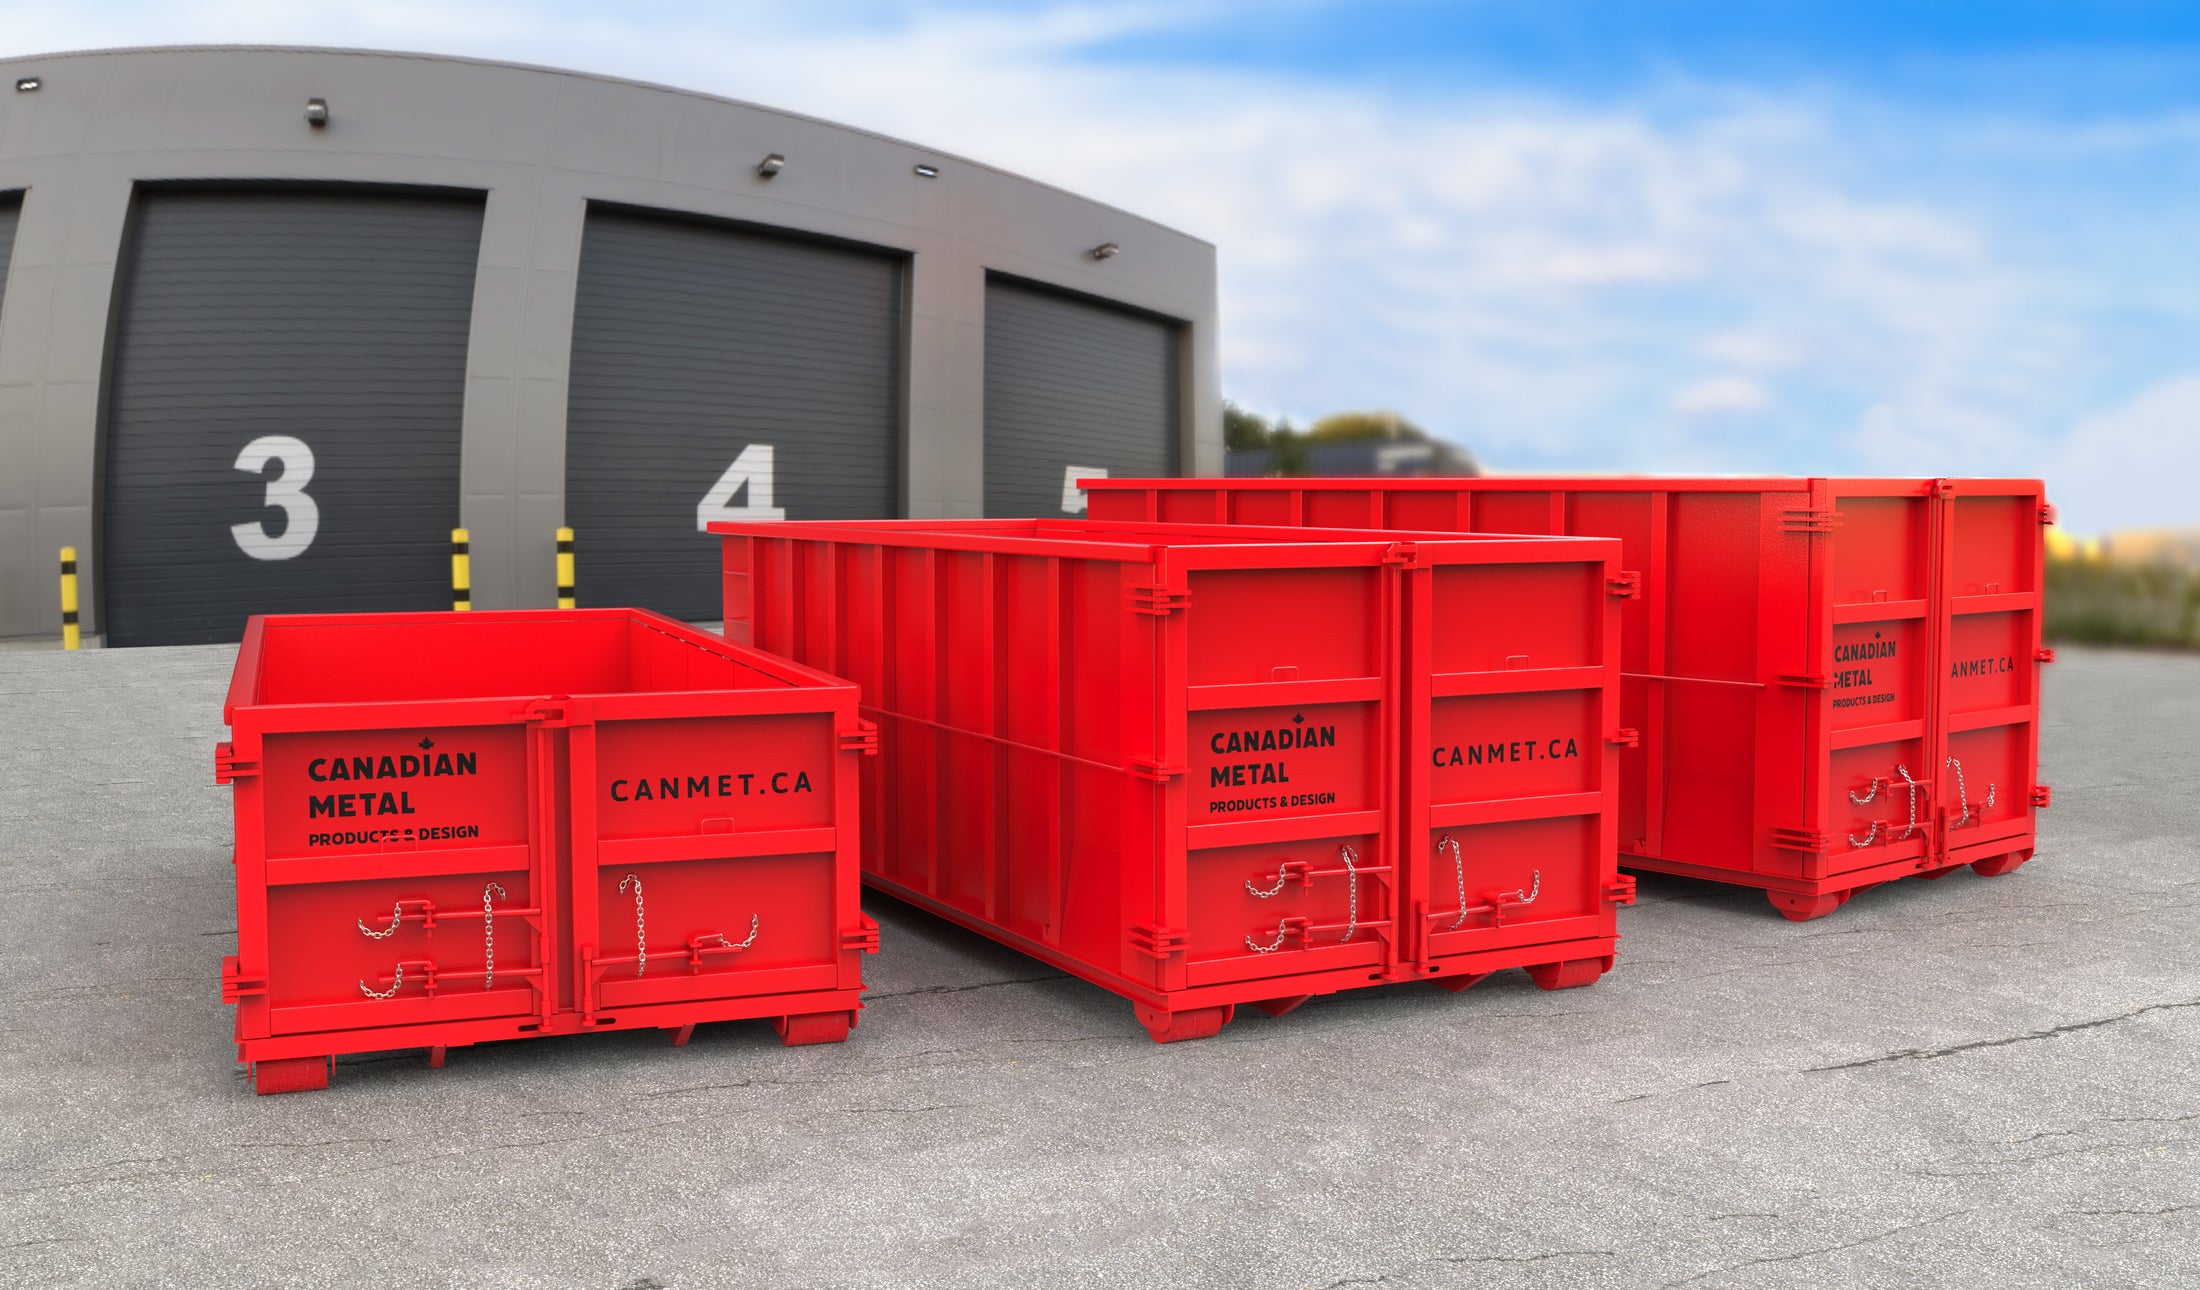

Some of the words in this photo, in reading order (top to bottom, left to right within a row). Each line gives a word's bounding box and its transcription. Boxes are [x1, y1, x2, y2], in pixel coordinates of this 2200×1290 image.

[231, 436, 319, 560] 3
[697, 444, 786, 531] 4
[1834, 641, 1896, 662] CANADIAN
[1833, 669, 1873, 689] METAL
[1951, 656, 2014, 678] ANMET.CA
[1832, 695, 1866, 709] PRODUCTS
[1867, 696, 1872, 705] &
[1872, 693, 1895, 704] DESIGN
[1210, 725, 1335, 754] CANADIAN
[1432, 738, 1578, 768] CANMET.CA
[308, 752, 476, 782] CANADIAN
[1210, 762, 1289, 787] METAL
[610, 771, 812, 802] CANMET.CA
[309, 791, 415, 819] METAL
[1209, 797, 1277, 813] PRODUCTS
[1279, 798, 1288, 808] &
[1290, 792, 1335, 807] DESIGN
[309, 829, 399, 847] PRODUCTS
[403, 828, 415, 842] &
[419, 825, 479, 841] DESIGN
